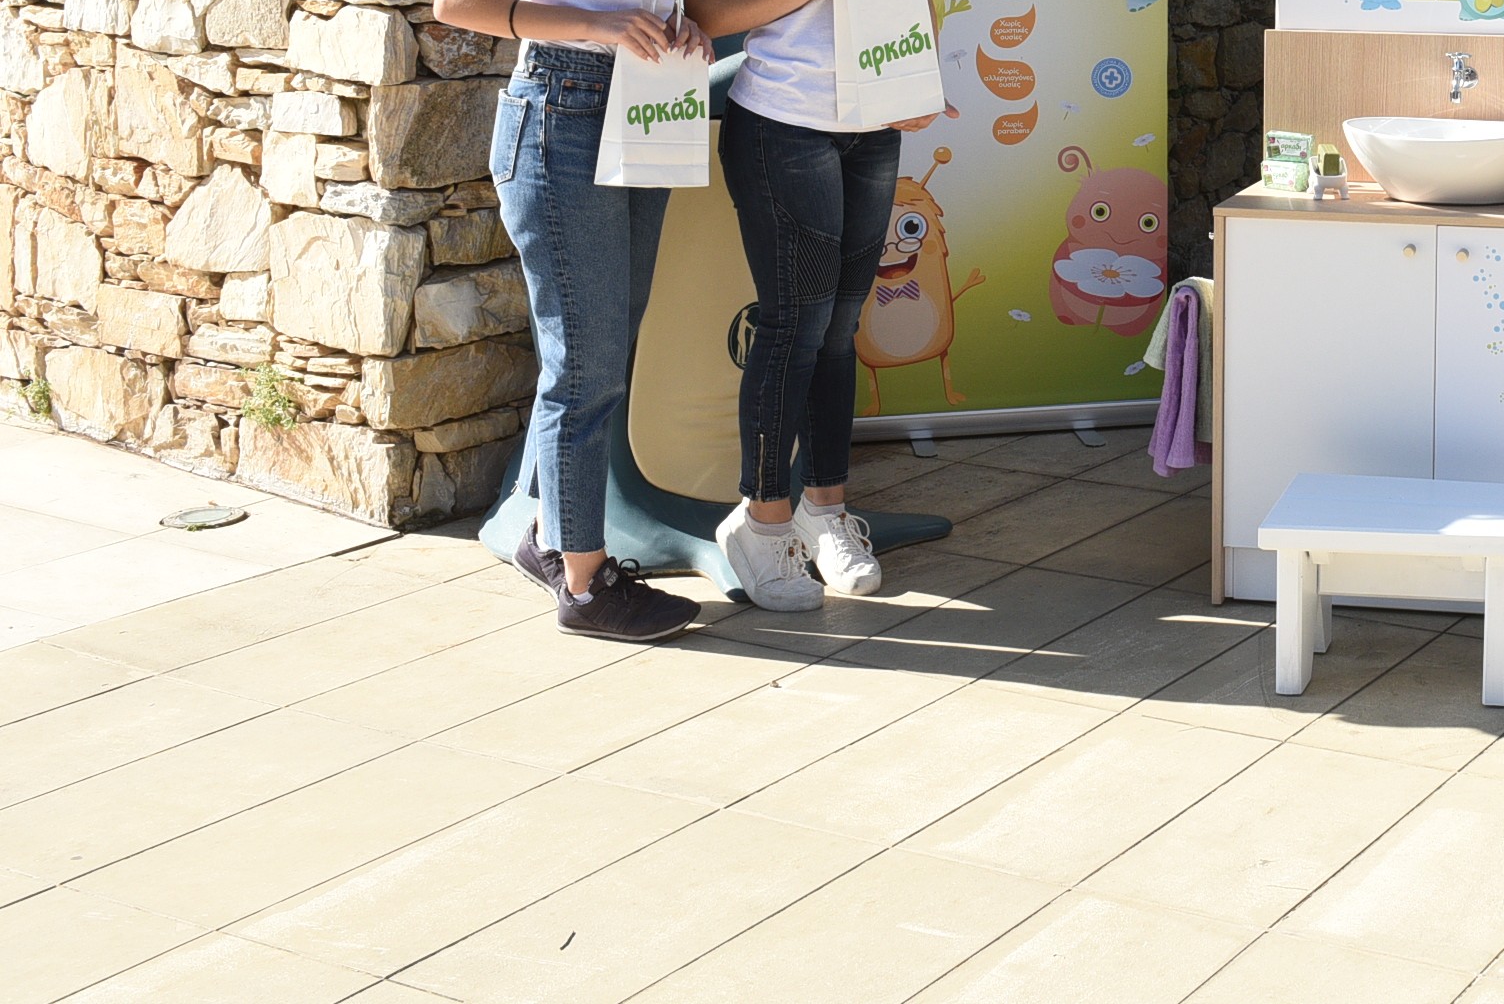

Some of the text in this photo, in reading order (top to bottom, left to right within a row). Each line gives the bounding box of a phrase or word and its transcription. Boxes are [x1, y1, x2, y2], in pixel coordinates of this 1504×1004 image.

[1000, 19, 1021, 27] Χωρίς
[994, 27, 1028, 35] χρωστικές
[859, 23, 932, 76] αρκάδι
[998, 67, 1020, 75] Χωρίς
[627, 88, 706, 135] αρκάδι
[1002, 120, 1024, 128] Χωρίς
[997, 128, 1030, 136] parabens
